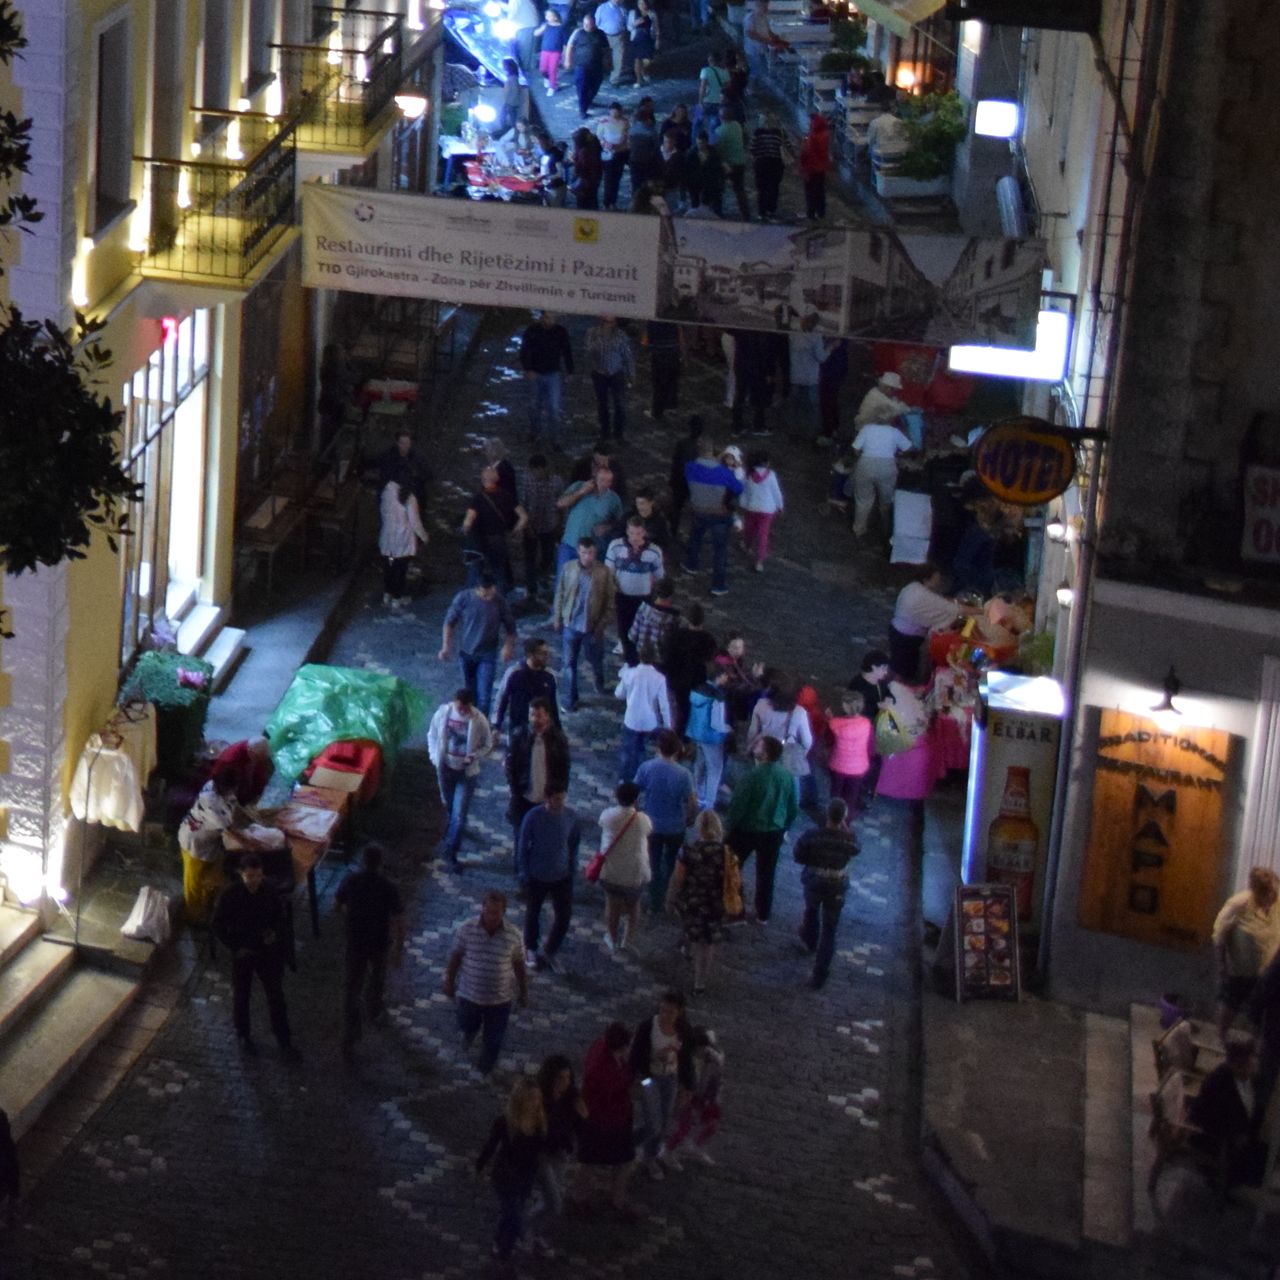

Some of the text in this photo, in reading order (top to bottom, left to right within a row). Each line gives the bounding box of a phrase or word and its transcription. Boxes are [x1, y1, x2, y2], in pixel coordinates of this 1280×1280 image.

[316, 235, 413, 260] Restaurimi
[418, 246, 454, 265] dhe
[560, 259, 566, 274] i
[573, 260, 639, 282] Pazarit
[431, 273, 466, 287] Zona
